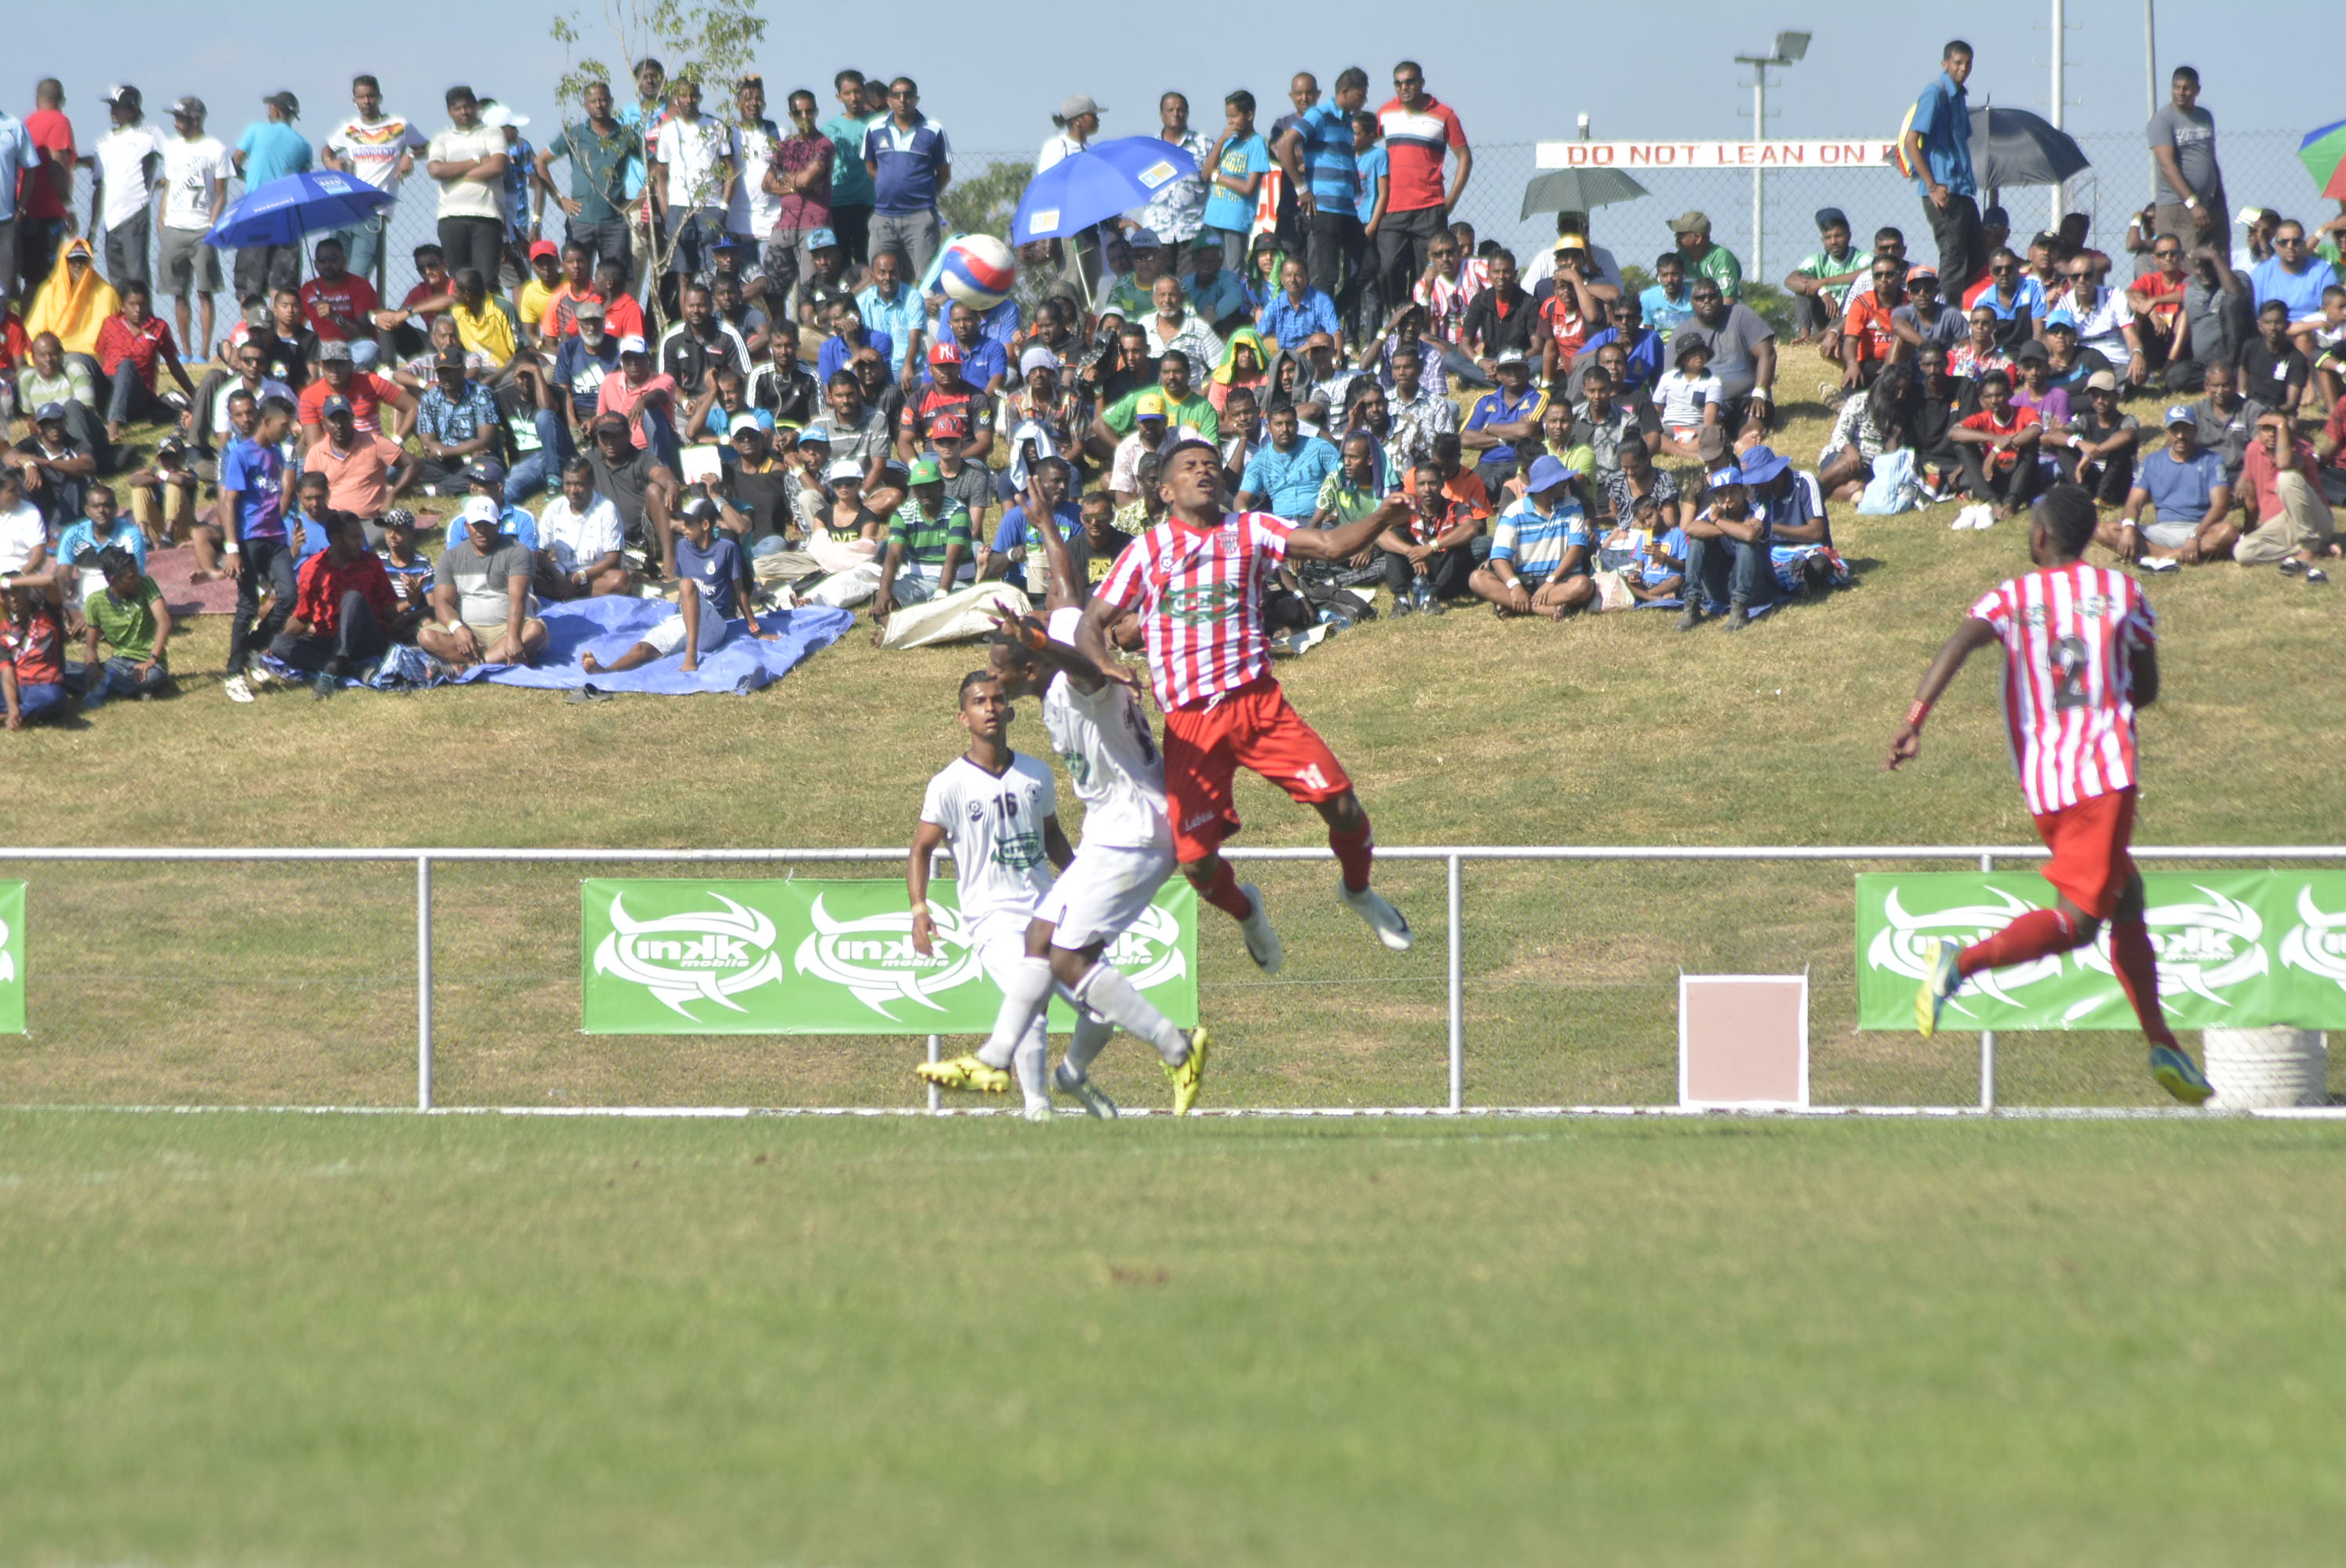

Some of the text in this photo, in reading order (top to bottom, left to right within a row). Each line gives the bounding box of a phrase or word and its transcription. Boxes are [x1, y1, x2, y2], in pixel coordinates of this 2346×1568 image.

[1567, 146, 1614, 165] DO
[1630, 146, 1700, 165] NOT
[1718, 145, 1803, 165] LEAN
[1819, 145, 1865, 164] ON
[2049, 635, 2090, 709] 2
[993, 792, 1019, 818] 16
